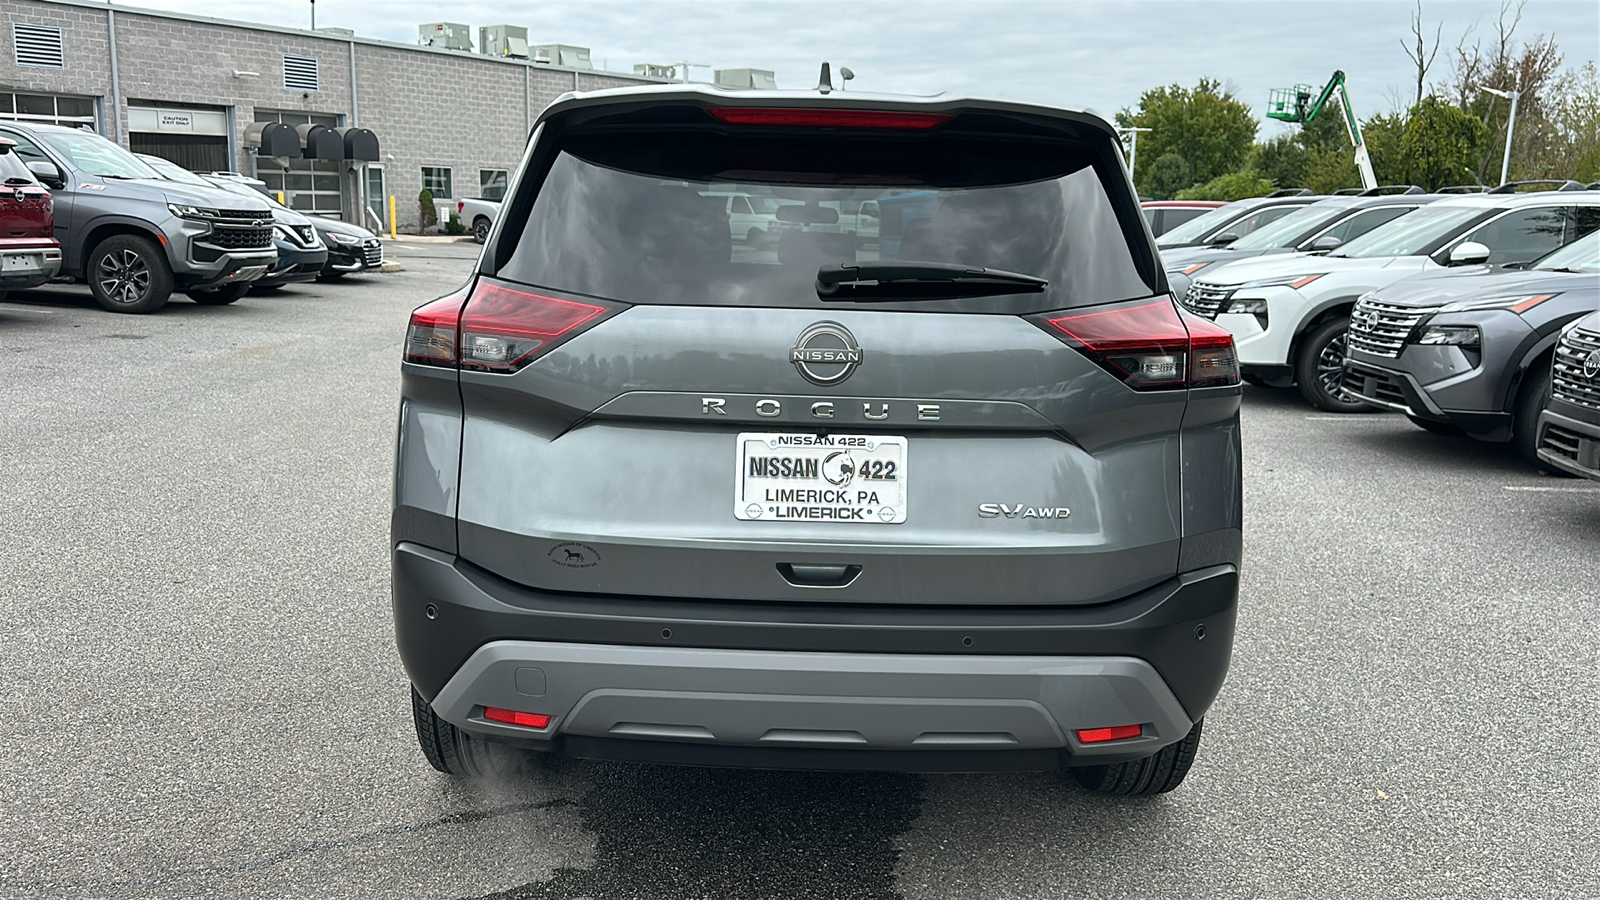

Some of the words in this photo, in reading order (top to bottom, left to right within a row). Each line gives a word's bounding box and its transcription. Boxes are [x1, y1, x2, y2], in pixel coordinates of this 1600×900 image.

[793, 350, 859, 361] NISSAN
[701, 397, 941, 421] ROGUE
[778, 436, 835, 446] NISSAN
[838, 437, 867, 447] 422
[749, 456, 819, 478] NISSAN
[859, 460, 897, 481] 422
[765, 488, 852, 505] LIMERICK,
[858, 491, 880, 504] PA
[775, 506, 865, 520] LIMERICK
[978, 503, 1024, 518] SV
[1022, 507, 1071, 519] AWD
